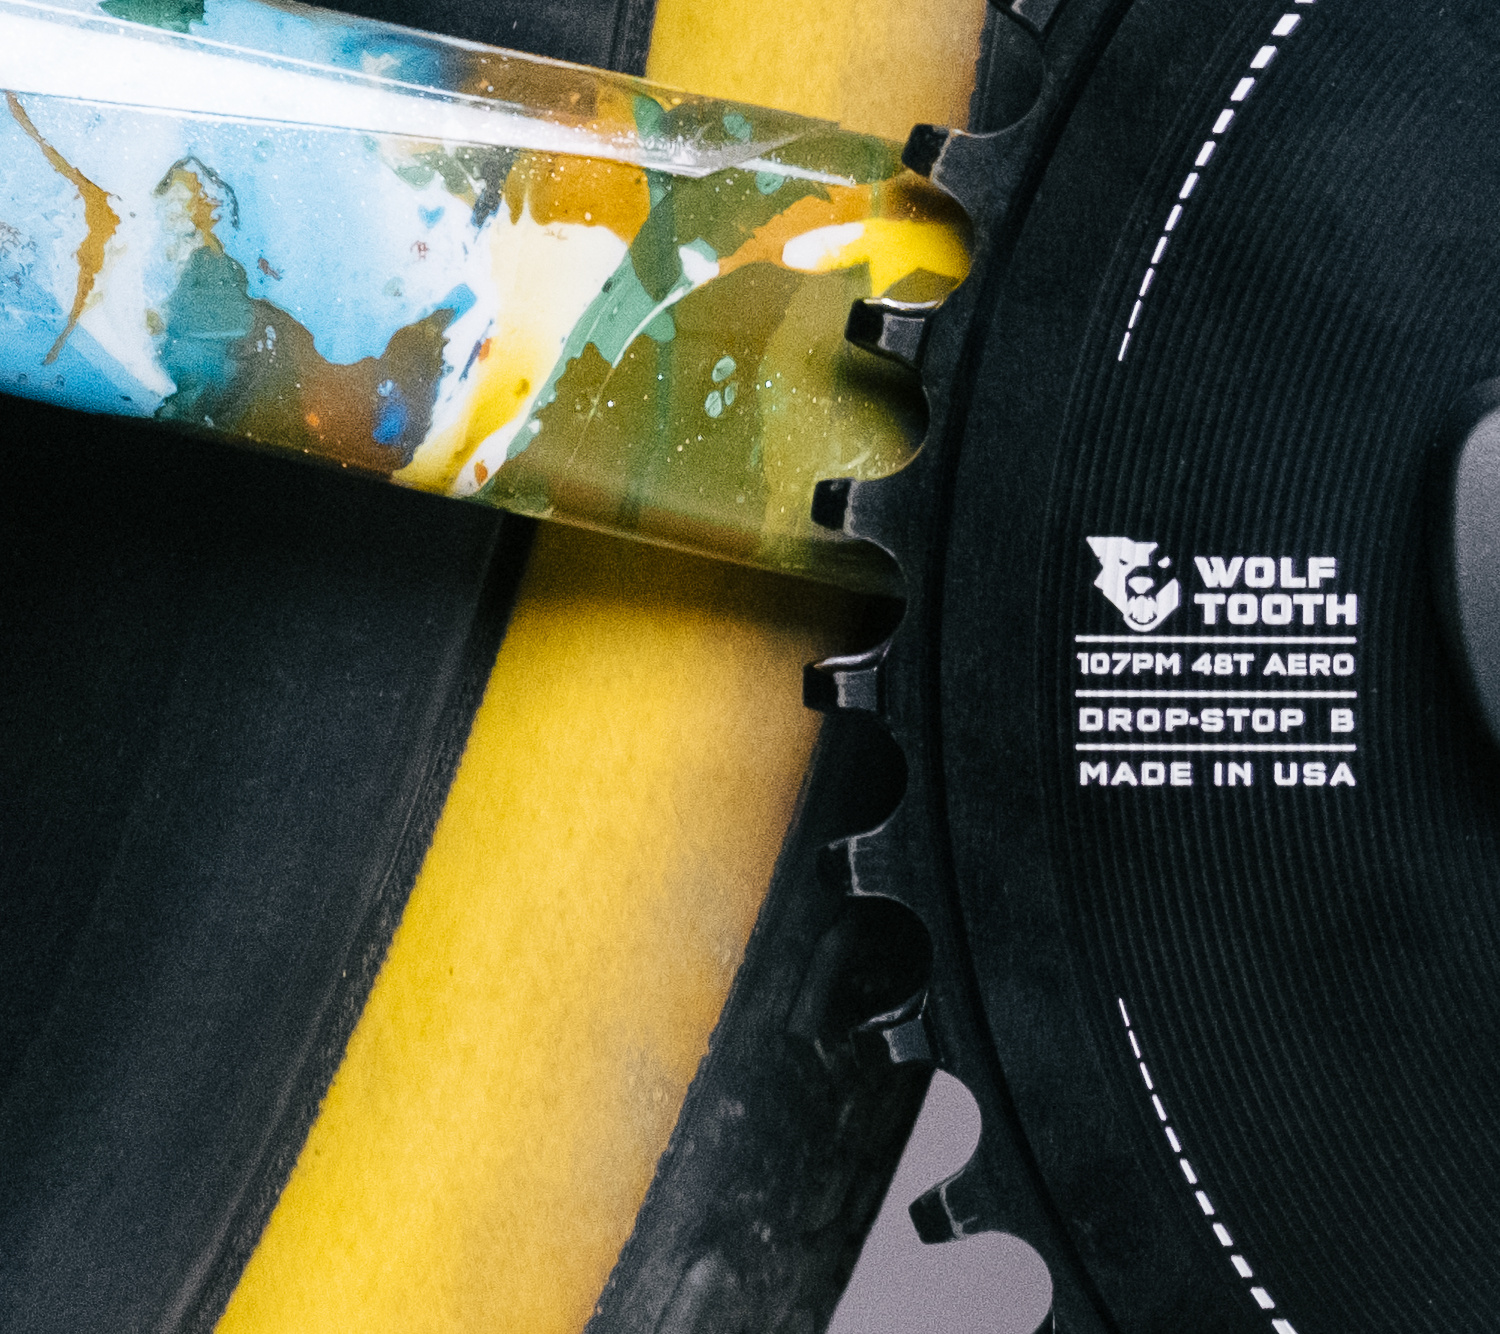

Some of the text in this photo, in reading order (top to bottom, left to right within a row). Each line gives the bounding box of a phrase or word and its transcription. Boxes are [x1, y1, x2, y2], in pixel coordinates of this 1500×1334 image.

[1194, 556, 1337, 589] WOLF
[1193, 593, 1358, 626] TOOTH
[1076, 652, 1356, 676] 107PM 48T AERO
[1078, 707, 1355, 733] DROP-STOP B
[1079, 761, 1357, 787] MADE IN USA
